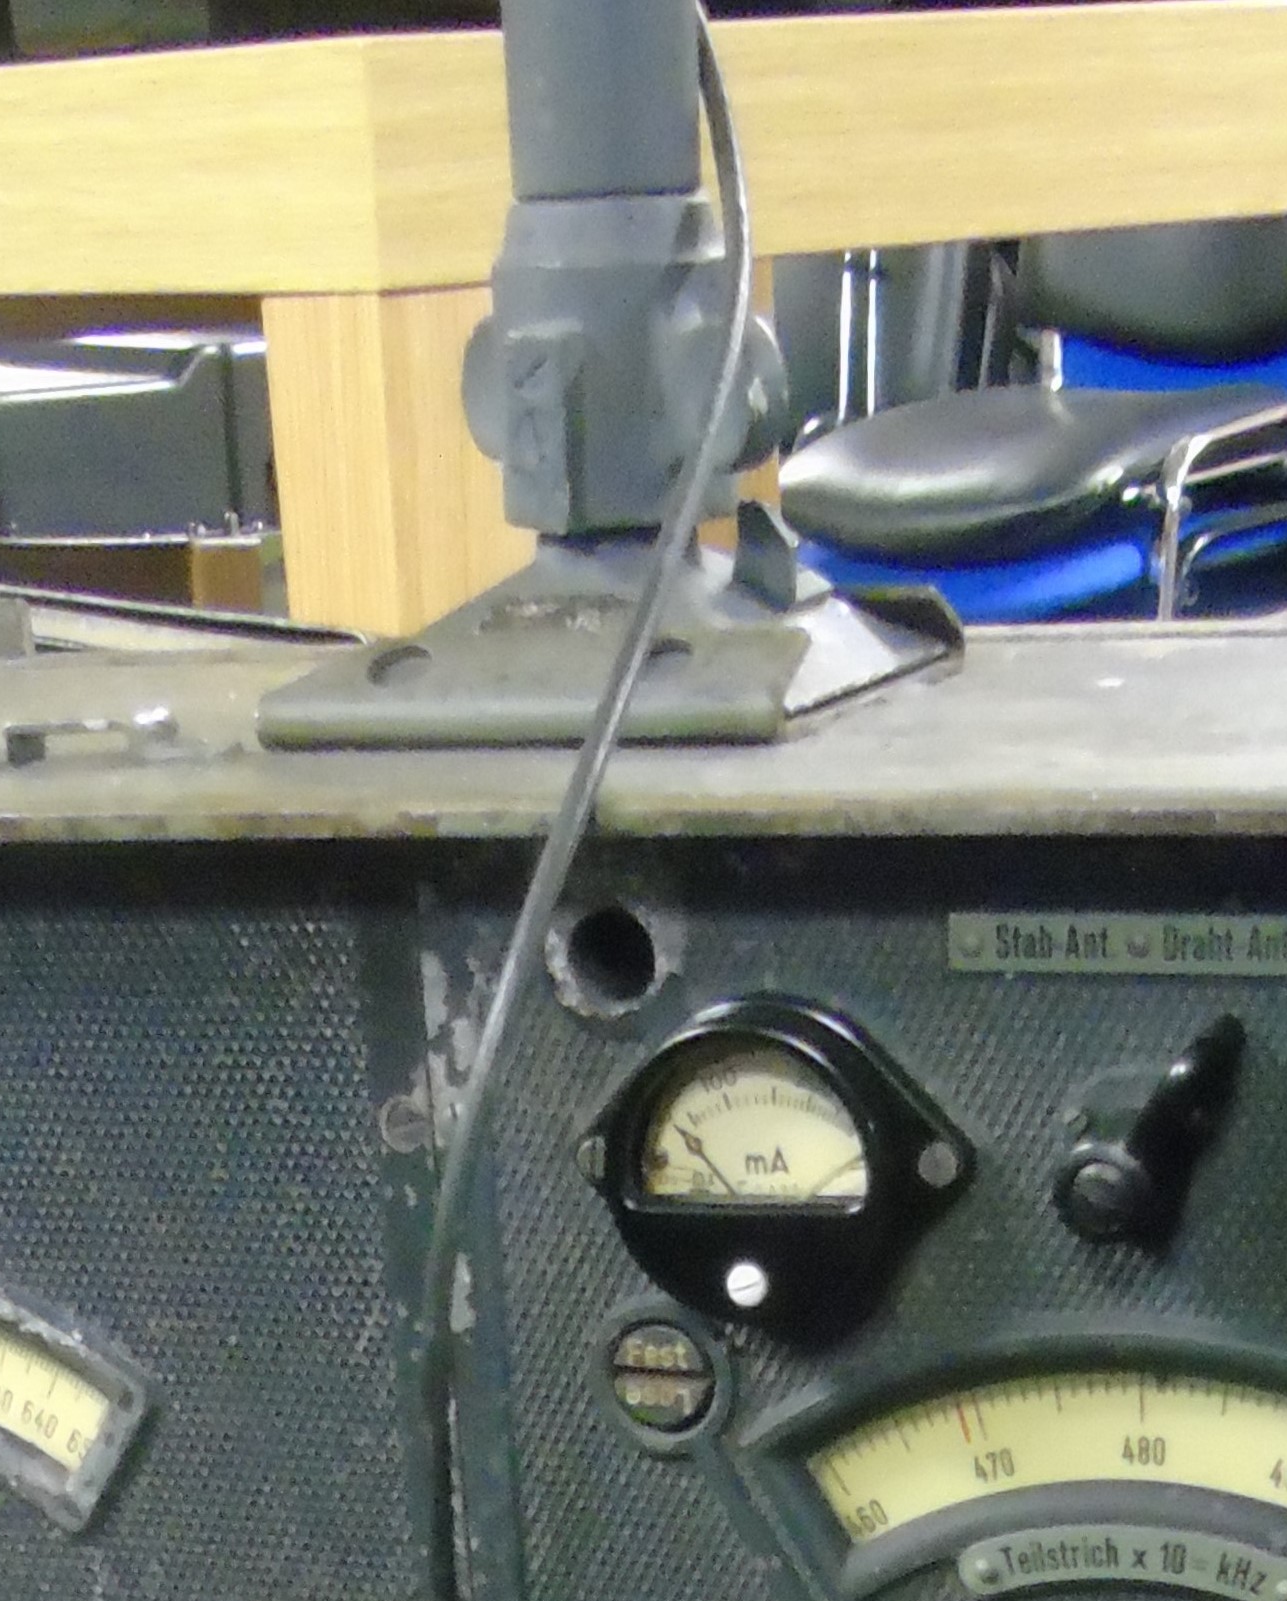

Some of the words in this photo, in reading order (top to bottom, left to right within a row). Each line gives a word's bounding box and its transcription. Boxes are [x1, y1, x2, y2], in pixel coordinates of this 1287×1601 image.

[744, 1145, 790, 1176] mA
[625, 1336, 689, 1370] Fest
[20, 1400, 59, 1440] 640
[974, 1448, 1016, 1483] 470
[1122, 1436, 1167, 1468] 480
[999, 1537, 1119, 1576] Teilstrich
[1160, 1542, 1187, 1575] 10
[1214, 1552, 1269, 1597] kHz
